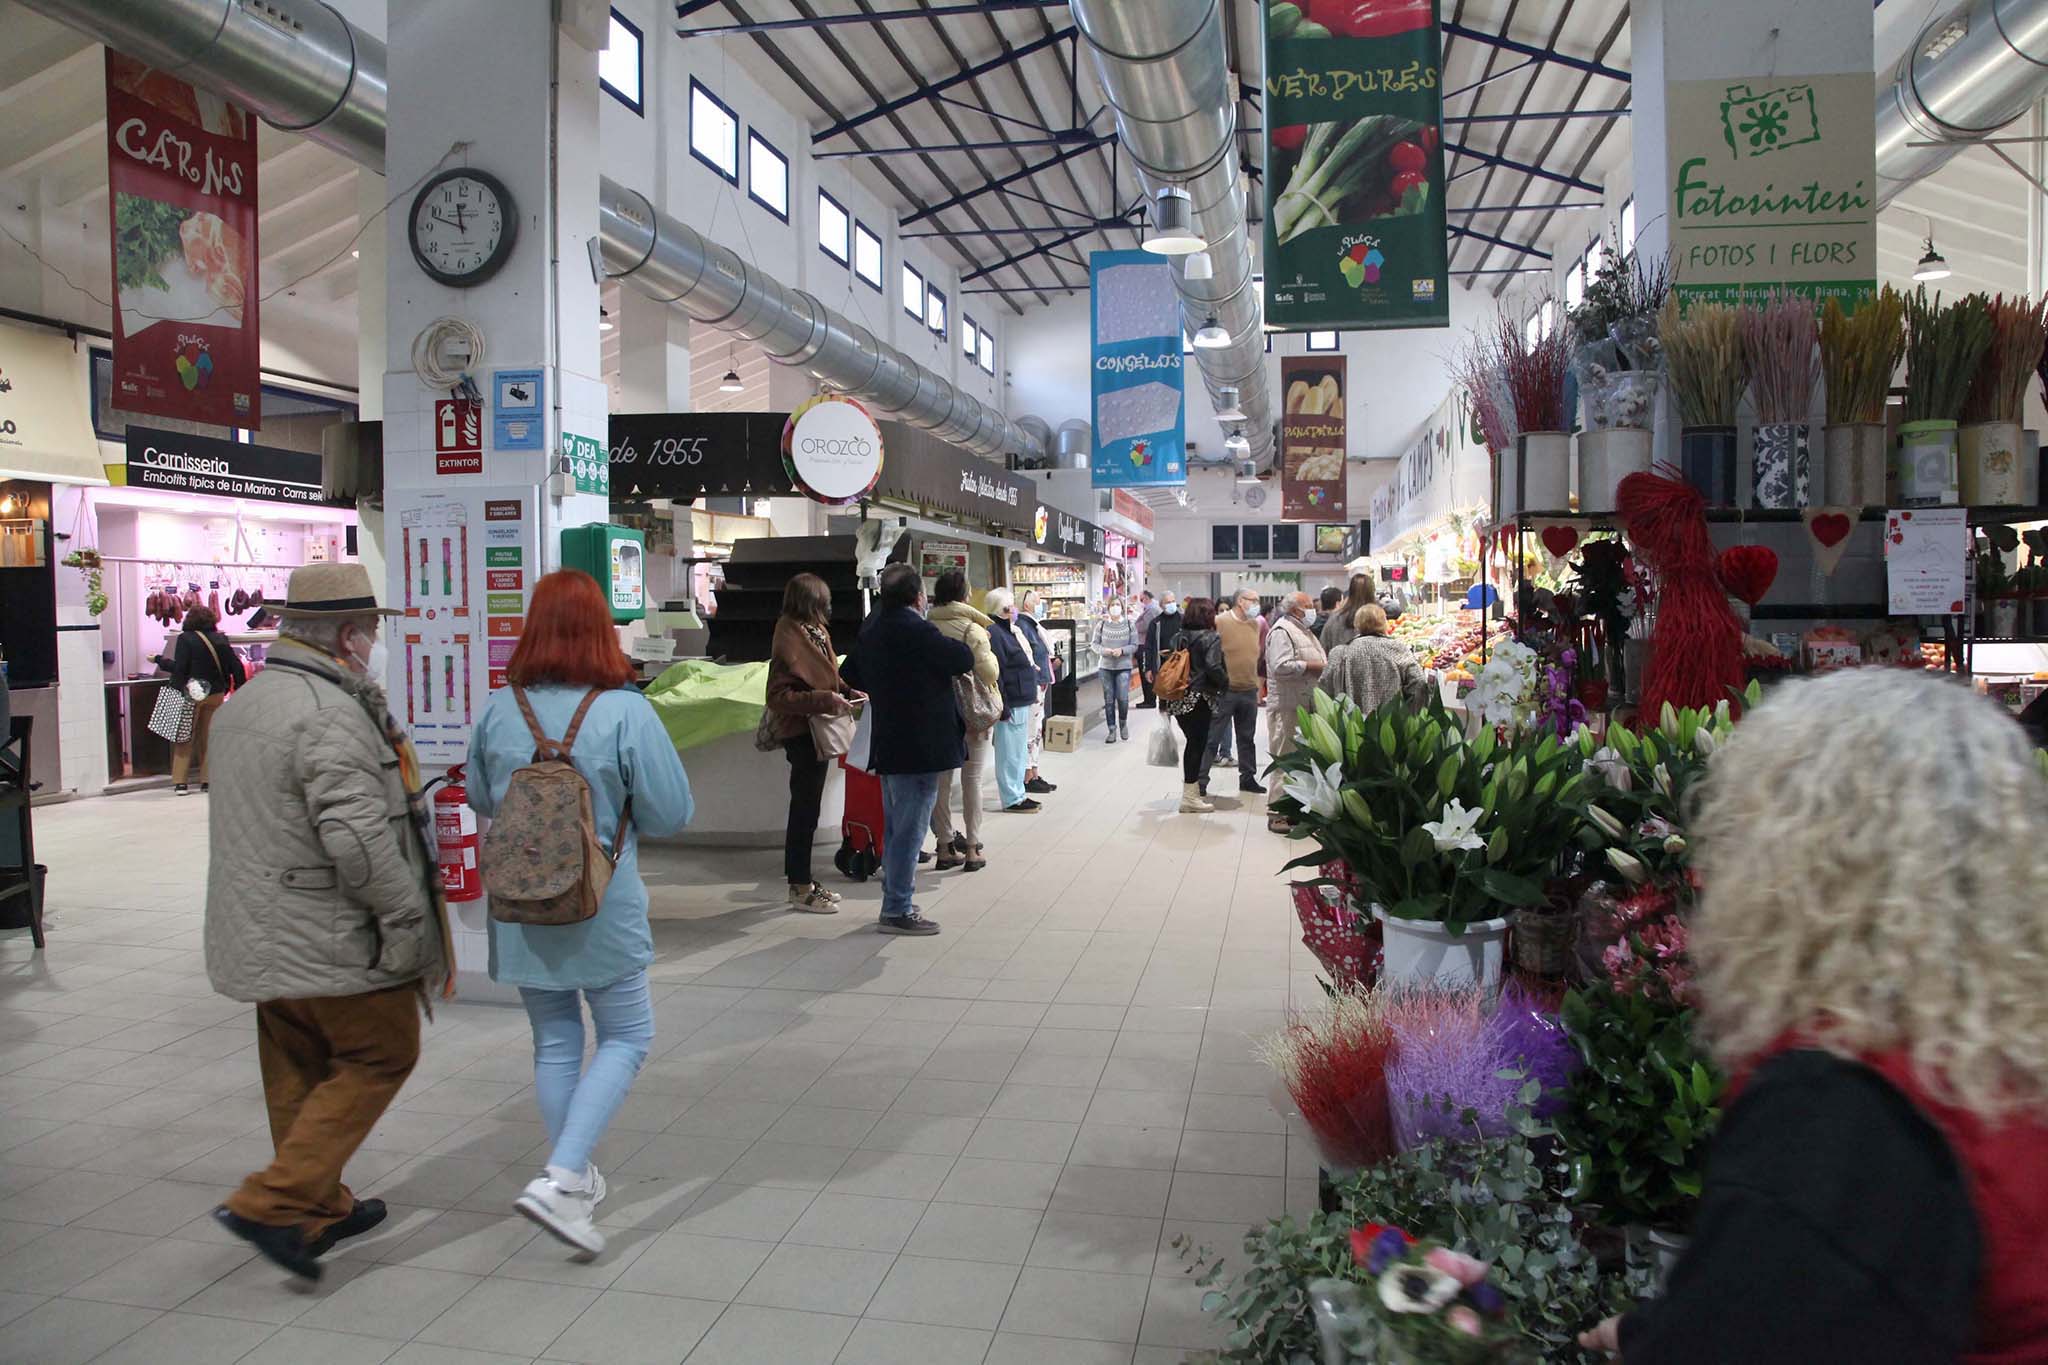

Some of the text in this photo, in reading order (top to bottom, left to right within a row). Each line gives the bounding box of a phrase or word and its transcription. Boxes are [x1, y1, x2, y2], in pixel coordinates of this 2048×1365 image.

[1266, 60, 1437, 100] VERDURES
[116, 118, 243, 195] CARNS
[1674, 157, 1870, 218] Fotosintesi
[1690, 240, 1857, 268] FOTOS I FLORS
[1679, 288, 1719, 300] Mercat
[1725, 286, 1780, 300] Municipl
[1096, 352, 1182, 373] CONGELATS
[577, 441, 596, 460] DEA
[647, 437, 709, 465] 1955
[801, 437, 871, 456] OROZCO
[144, 447, 229, 474] Carnisseria
[439, 459, 479, 467] EXTINTOR
[143, 470, 187, 486] Embotits
[217, 479, 230, 491] de
[232, 482, 243, 492] La
[244, 483, 276, 496] Marina
[282, 486, 307, 499] Carns
